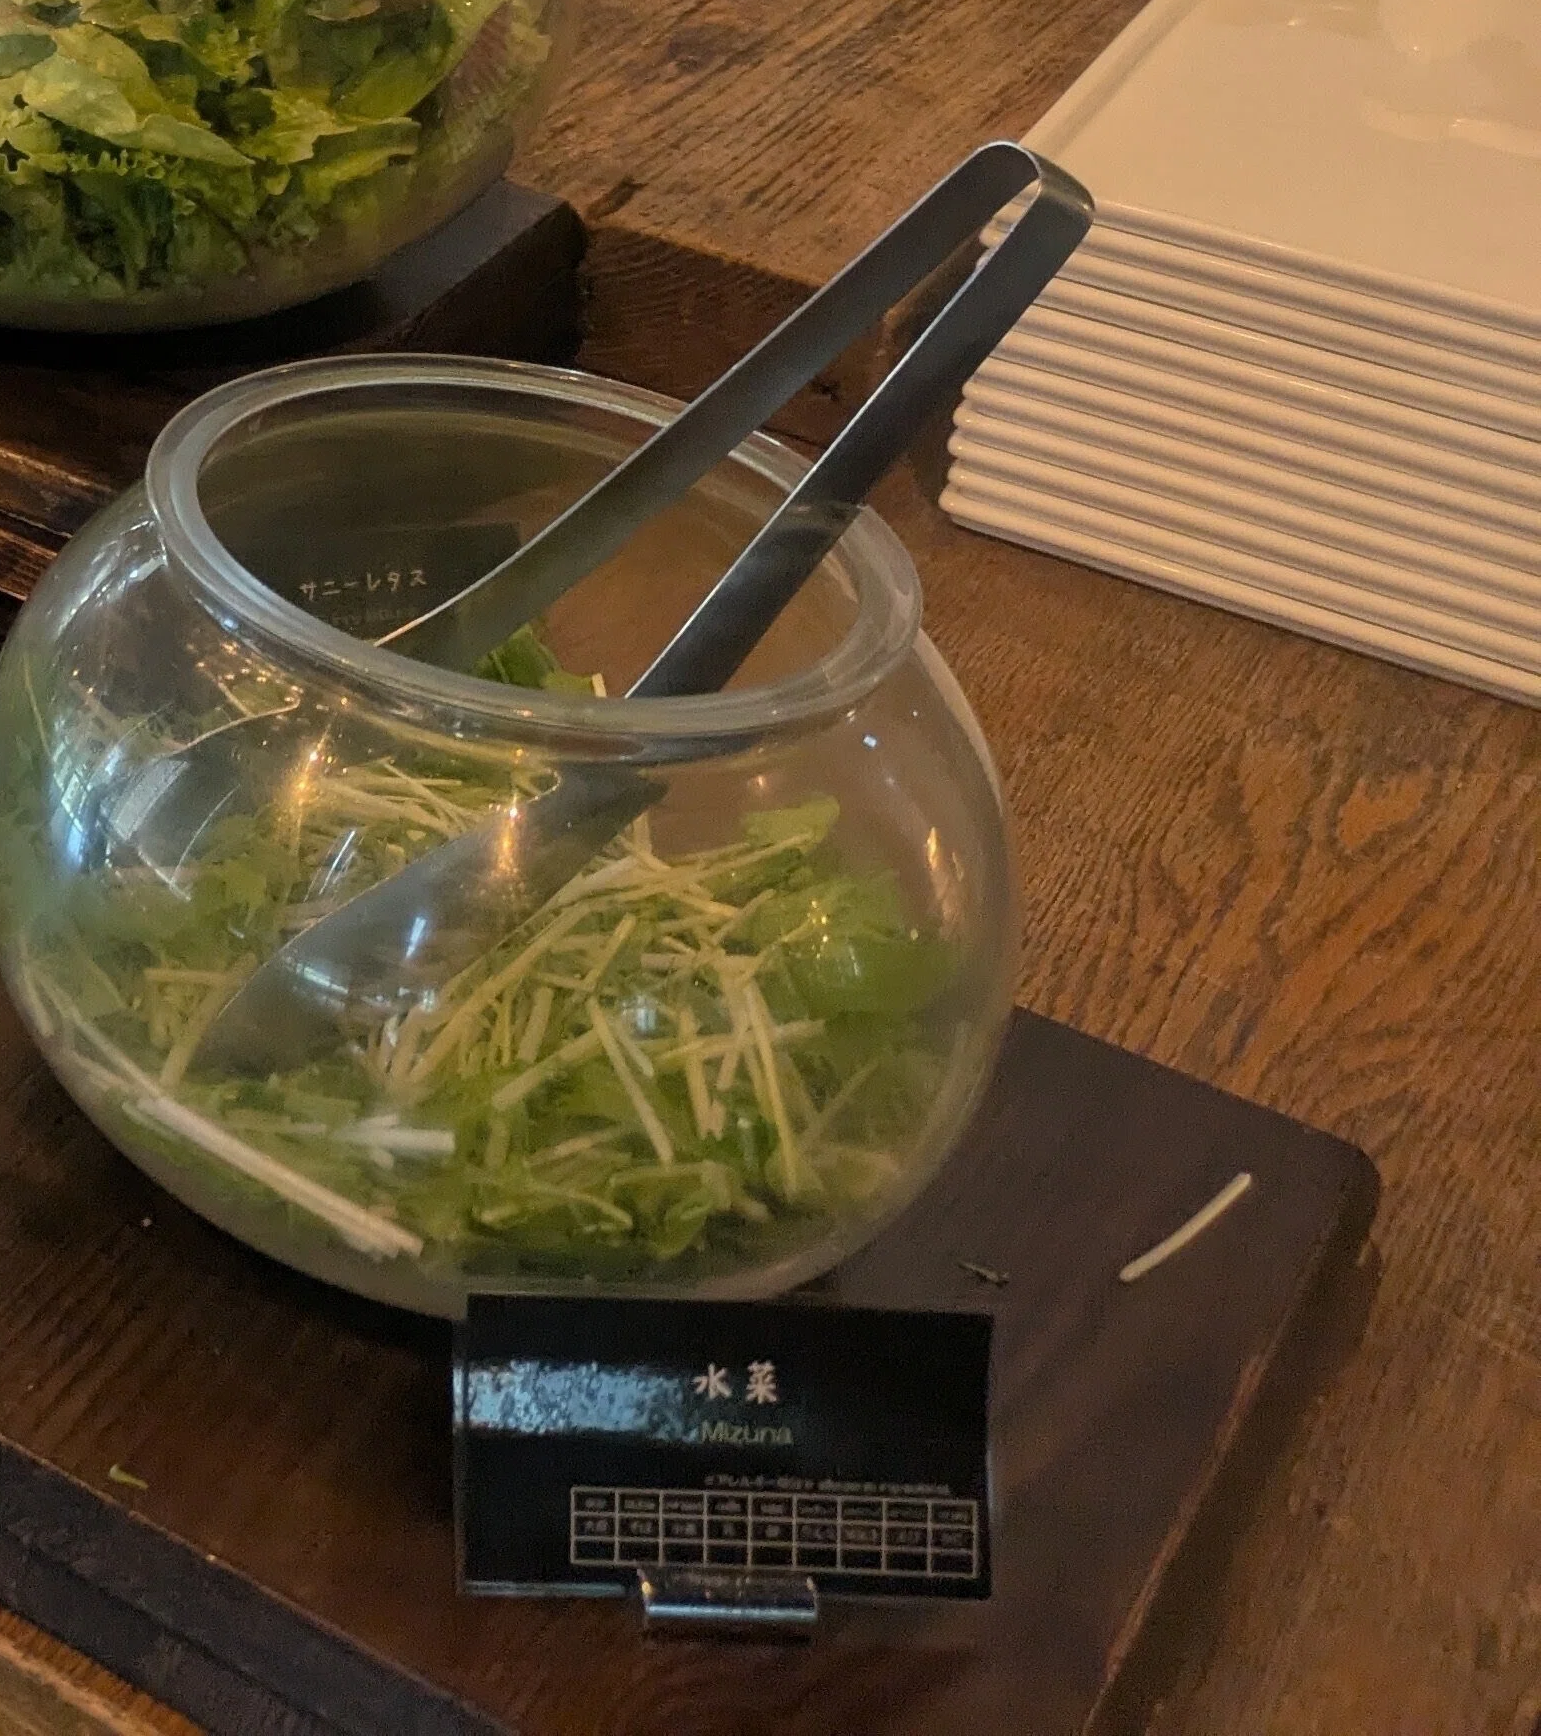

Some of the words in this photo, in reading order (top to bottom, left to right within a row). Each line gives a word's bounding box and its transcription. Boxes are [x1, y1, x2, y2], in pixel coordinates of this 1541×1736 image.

[299, 569, 427, 601] サニーレタス
[692, 1360, 778, 1404] 水菜
[701, 1420, 794, 1445] Mizuna
